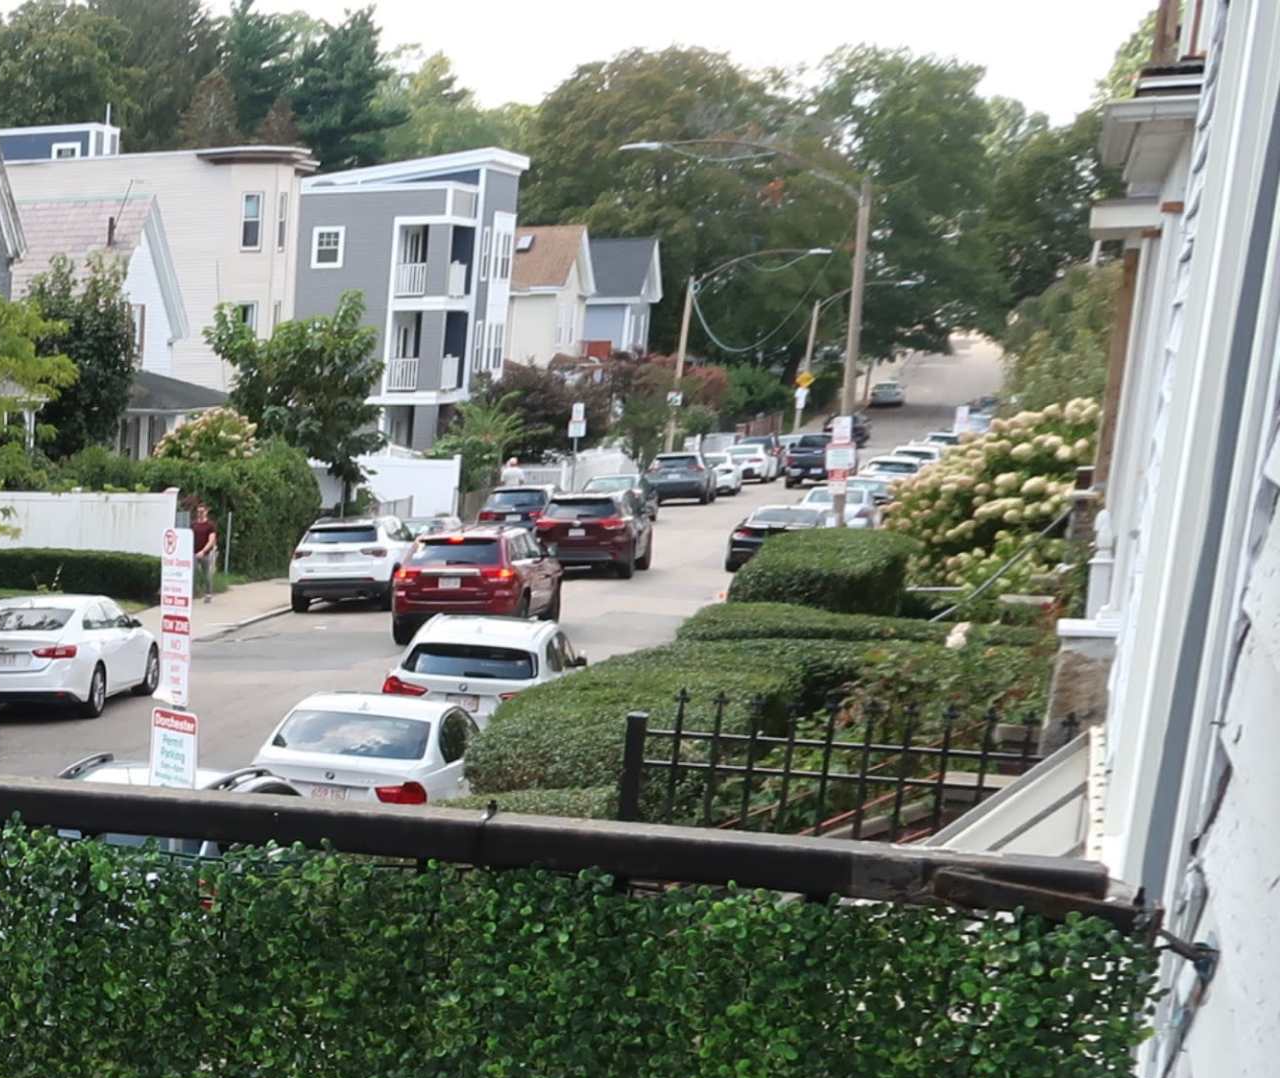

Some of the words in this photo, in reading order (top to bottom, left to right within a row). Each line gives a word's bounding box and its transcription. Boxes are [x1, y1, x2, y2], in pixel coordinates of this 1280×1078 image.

[155, 711, 195, 731] Dorchester
[162, 734, 184, 748] Permit
[160, 746, 185, 764] Parking
